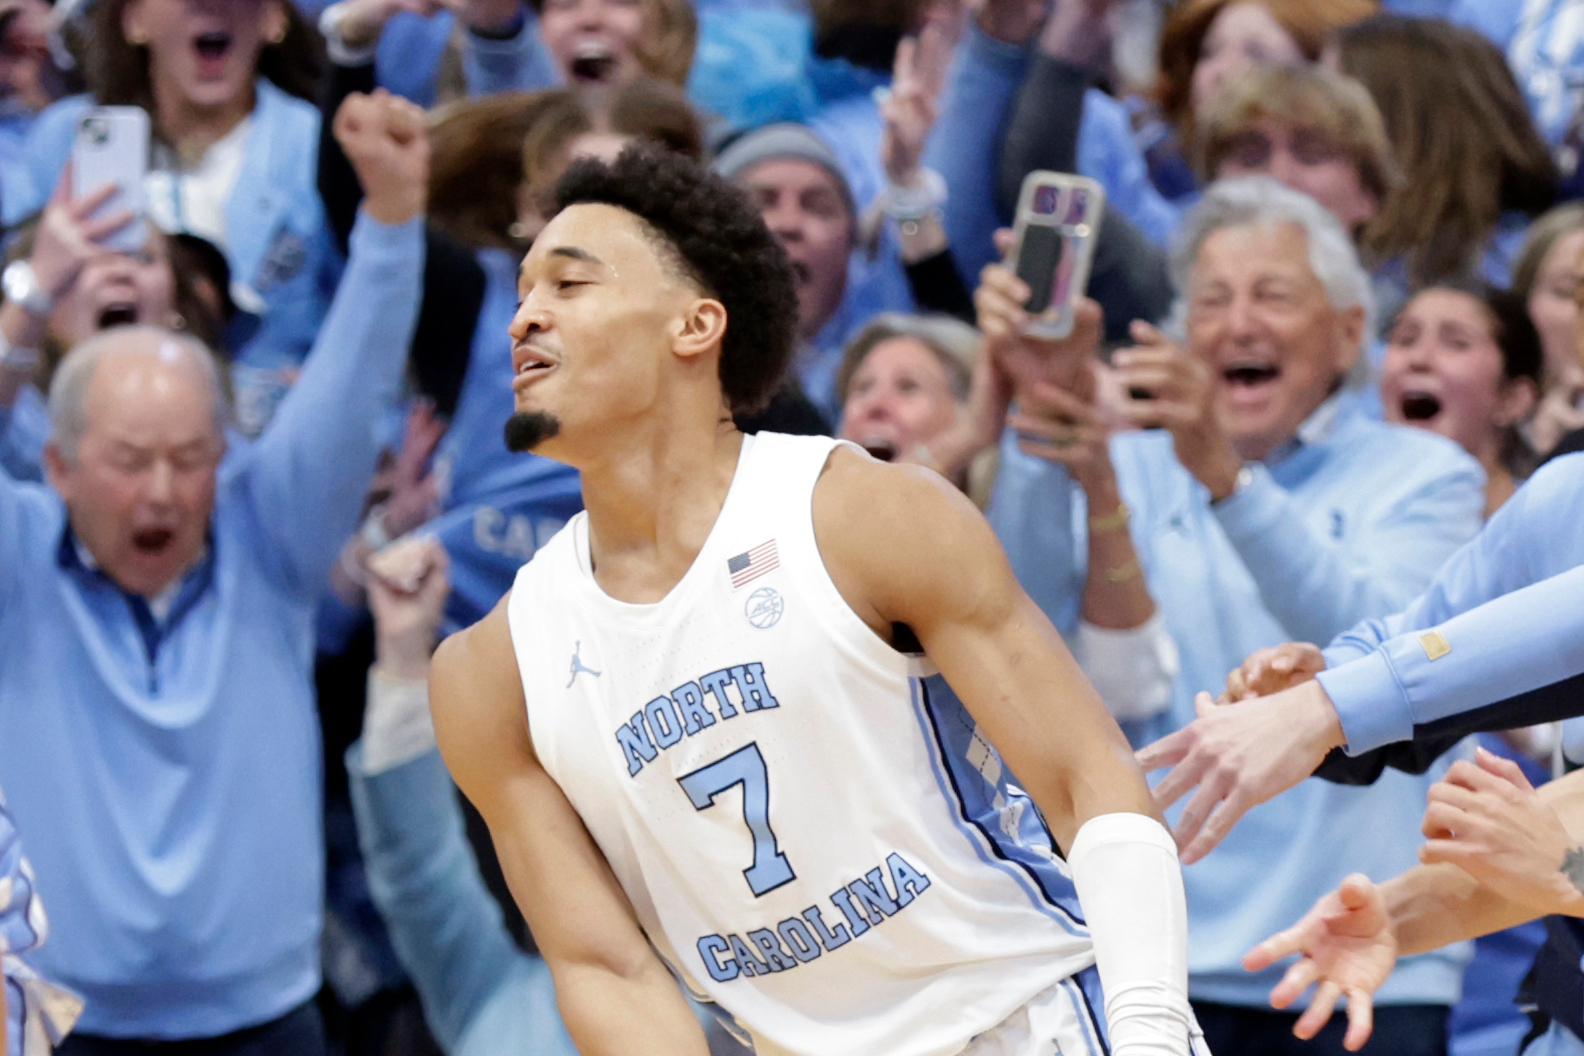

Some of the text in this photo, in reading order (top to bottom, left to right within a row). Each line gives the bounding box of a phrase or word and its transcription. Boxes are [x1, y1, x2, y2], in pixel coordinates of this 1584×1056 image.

[615, 661, 780, 778] NORTH
[676, 740, 797, 898] 7
[696, 851, 932, 983] CAROLINA
